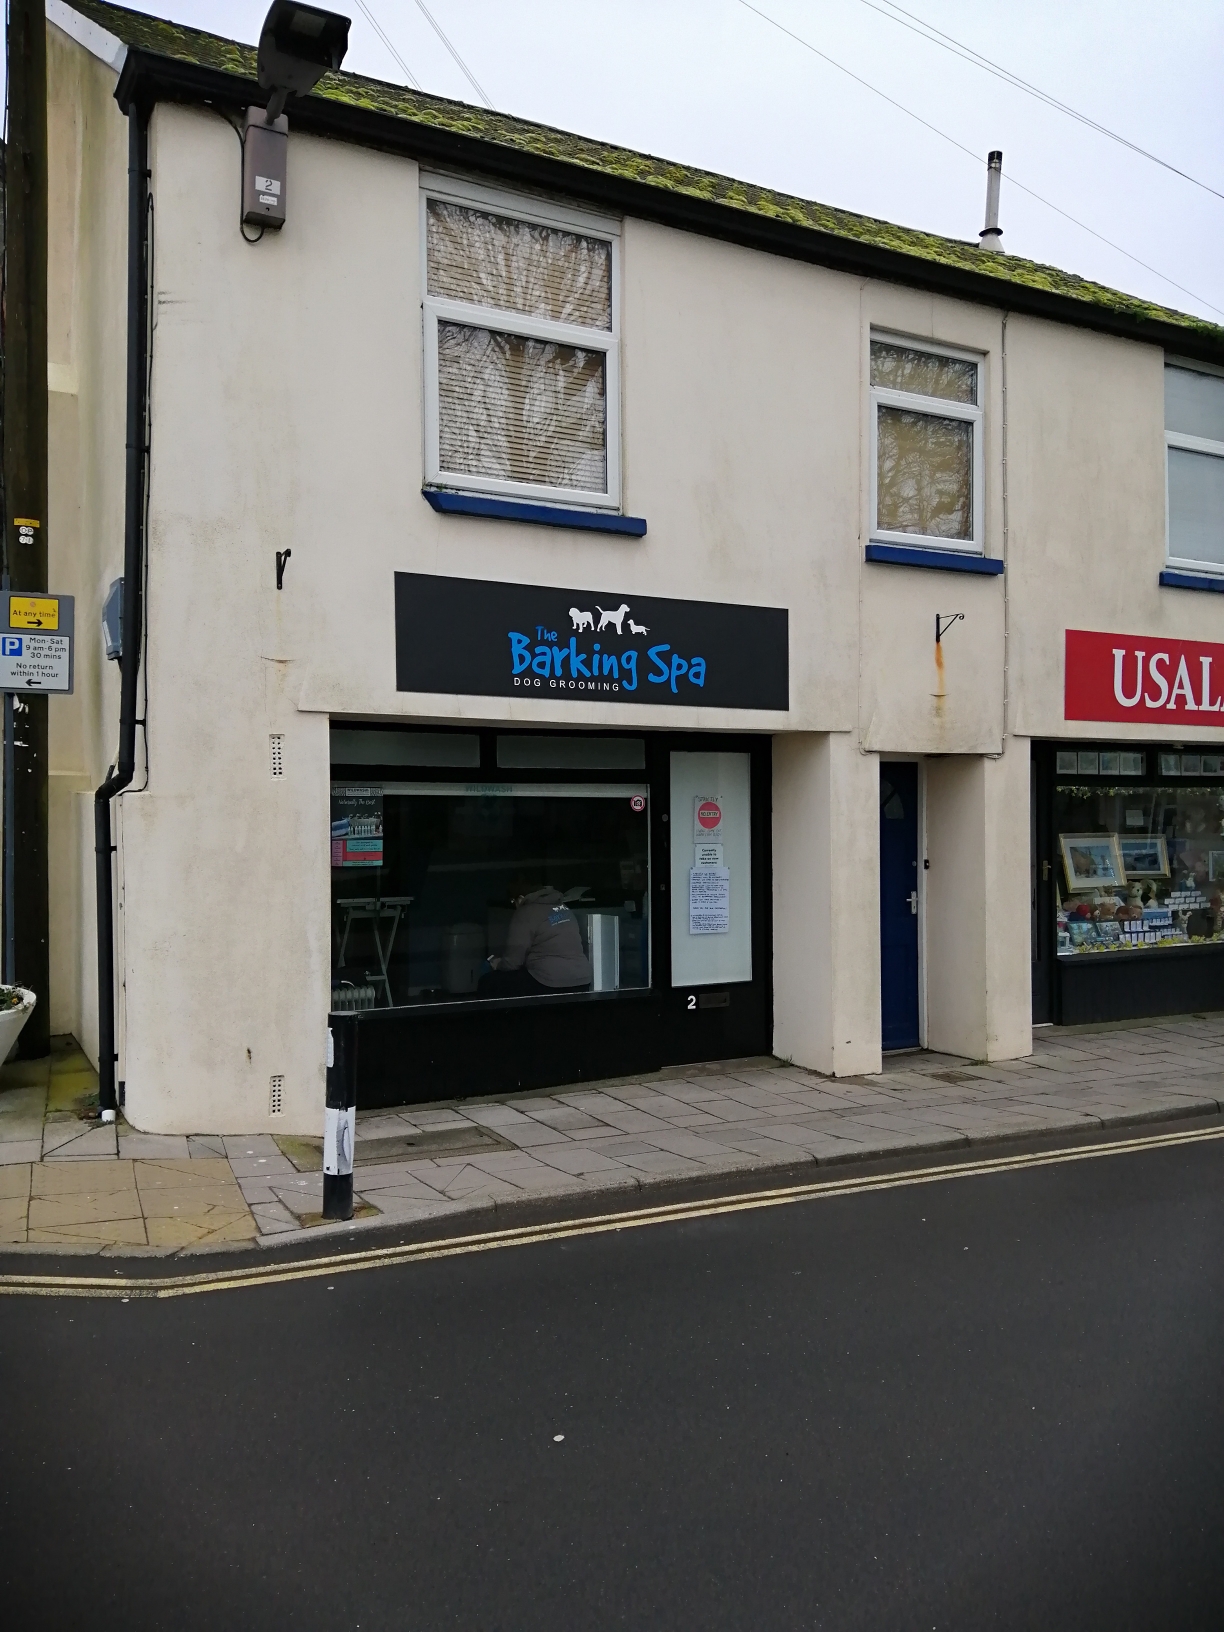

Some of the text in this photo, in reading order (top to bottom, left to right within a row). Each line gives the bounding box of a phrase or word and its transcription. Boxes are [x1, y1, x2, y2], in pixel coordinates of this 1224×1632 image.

[264, 179, 273, 191] 2
[23, 610, 37, 618] any
[535, 626, 558, 643] The
[5, 638, 20, 655] P
[43, 652, 62, 660] mins
[507, 631, 706, 694] Barking Spa
[16, 662, 27, 670] No
[513, 677, 620, 692] DOG GROOMING
[465, 784, 513, 793] WILDWASH
[687, 995, 697, 1010] 2
